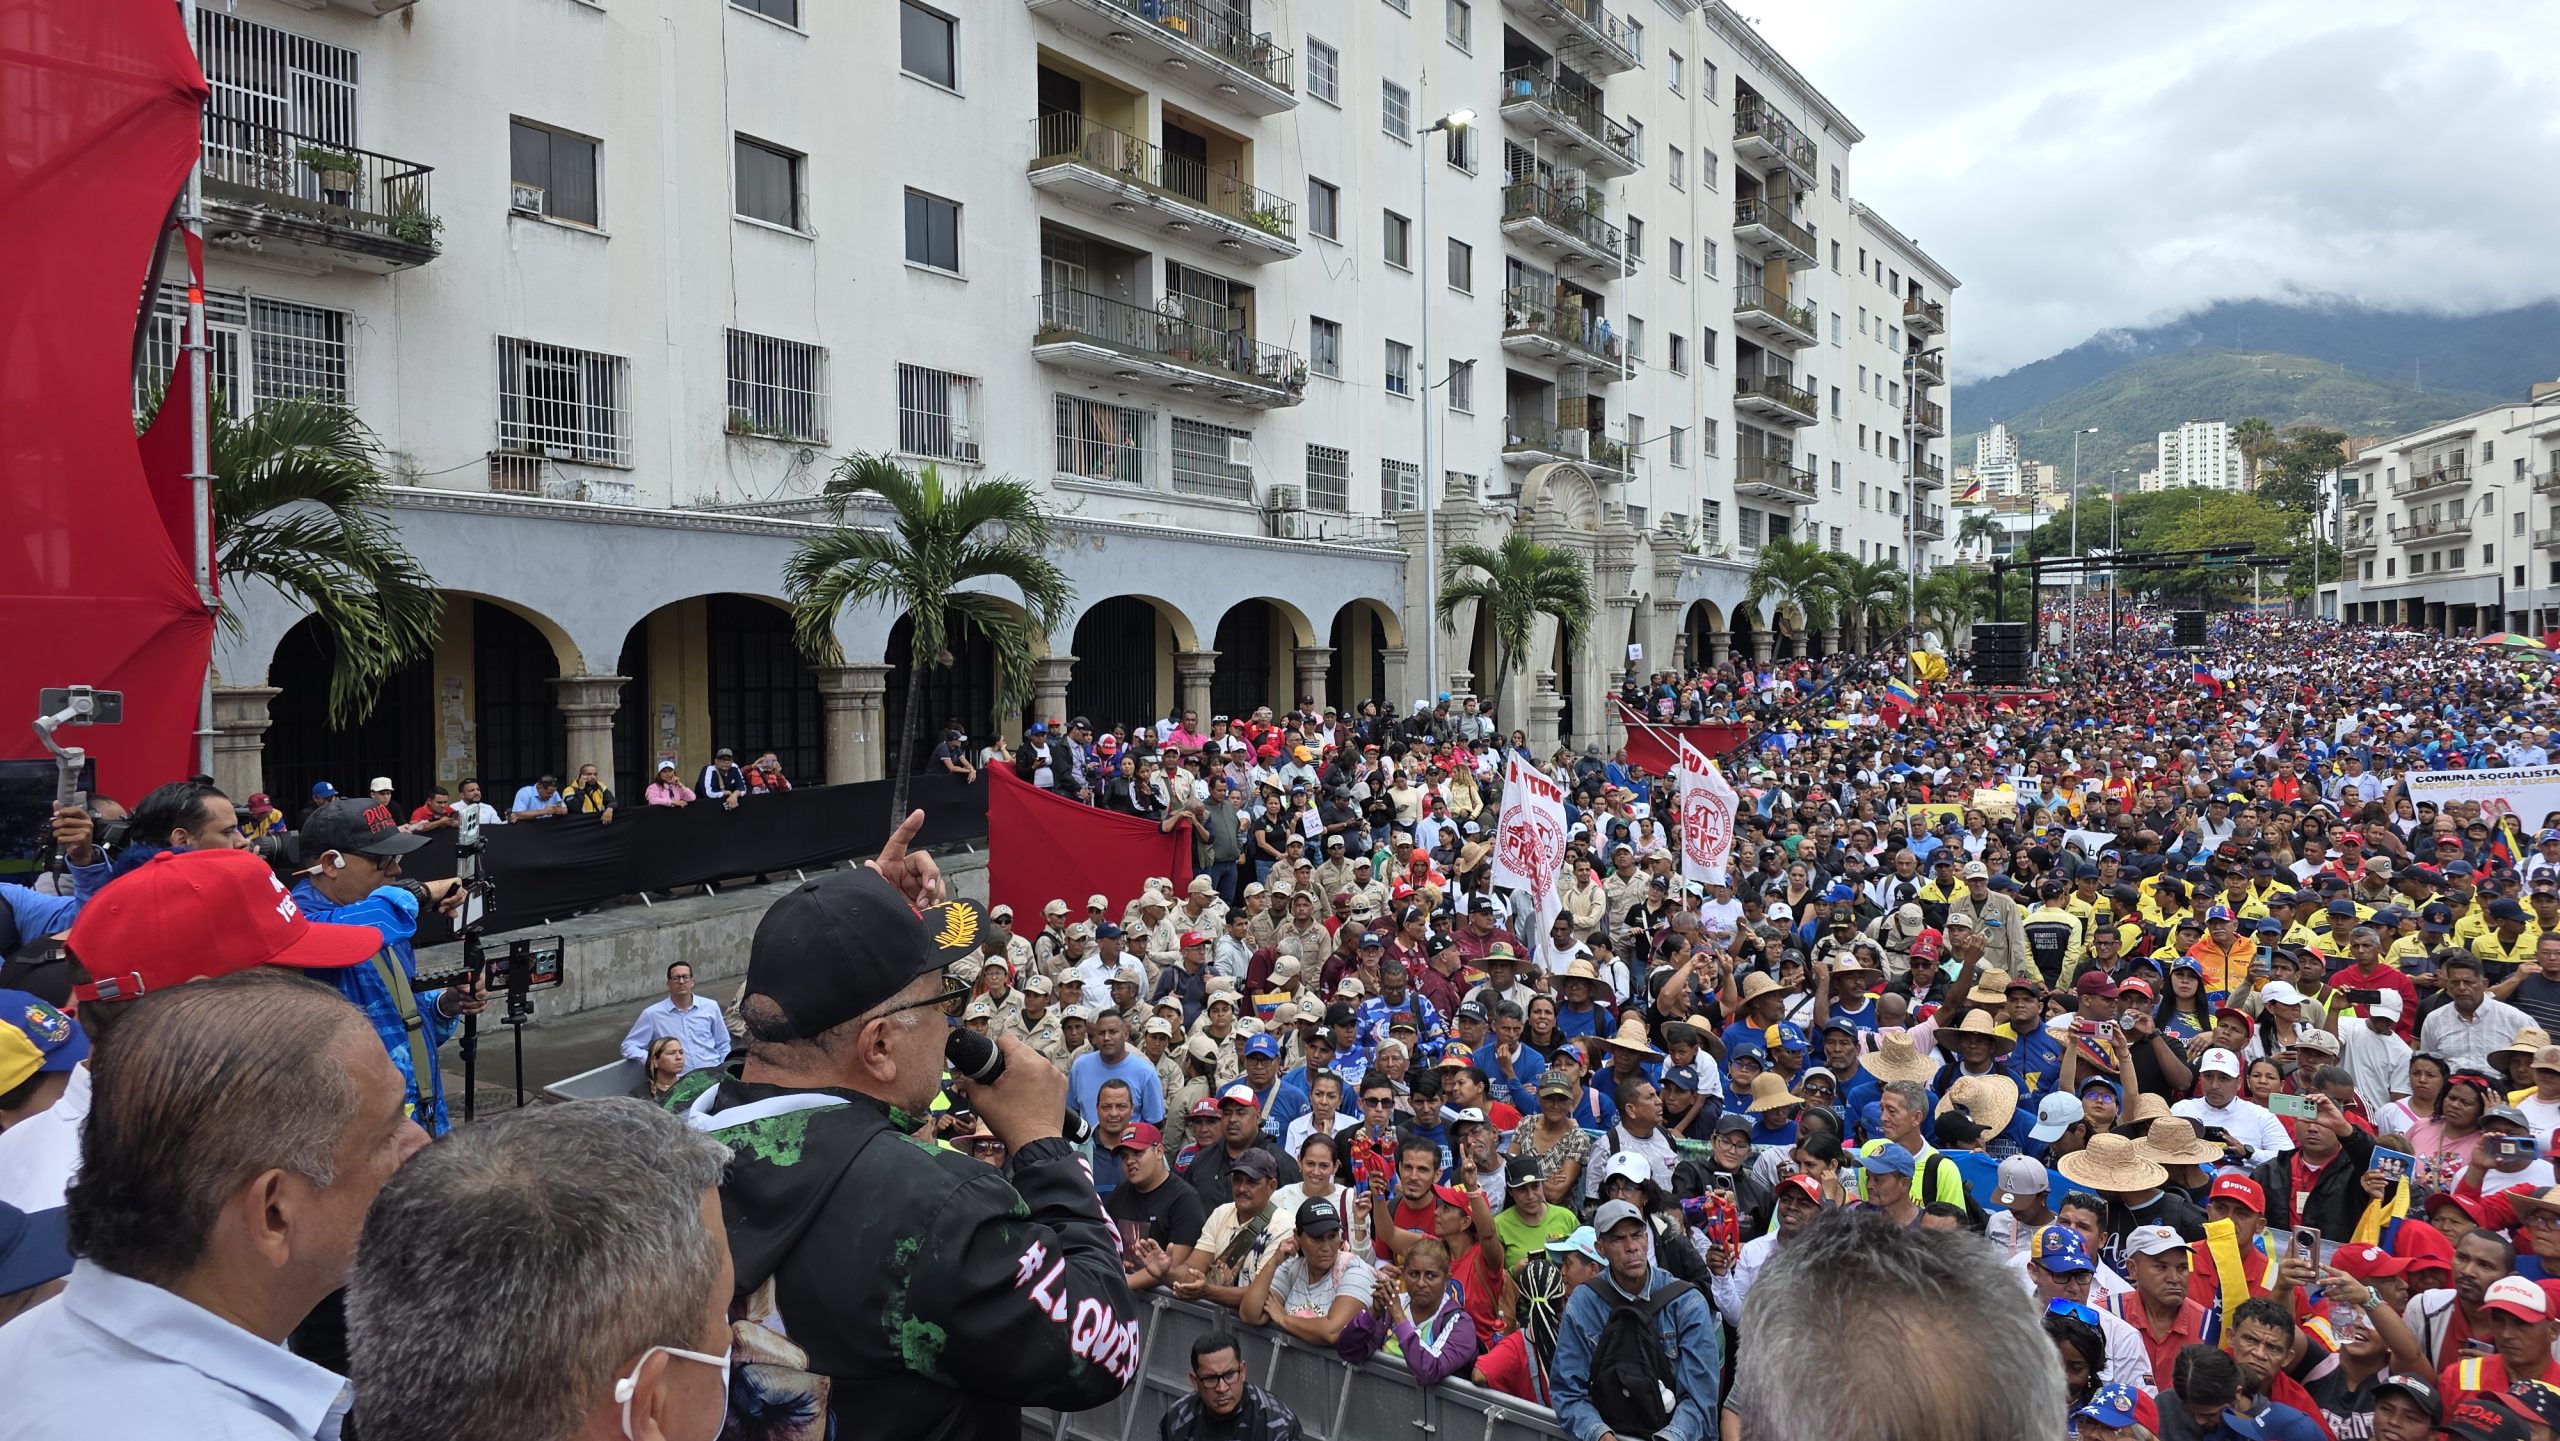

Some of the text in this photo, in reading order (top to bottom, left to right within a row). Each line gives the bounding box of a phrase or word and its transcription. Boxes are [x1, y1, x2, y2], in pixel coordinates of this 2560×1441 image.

[2415, 769, 2560, 783] COMUNA SOCIALISTA
[2411, 782, 2465, 790] ANTONIO
[1498, 853, 1525, 877] FABRICIO
[1460, 1003, 1480, 1014] PESCA
[2230, 1182, 2252, 1194] PDVSA
